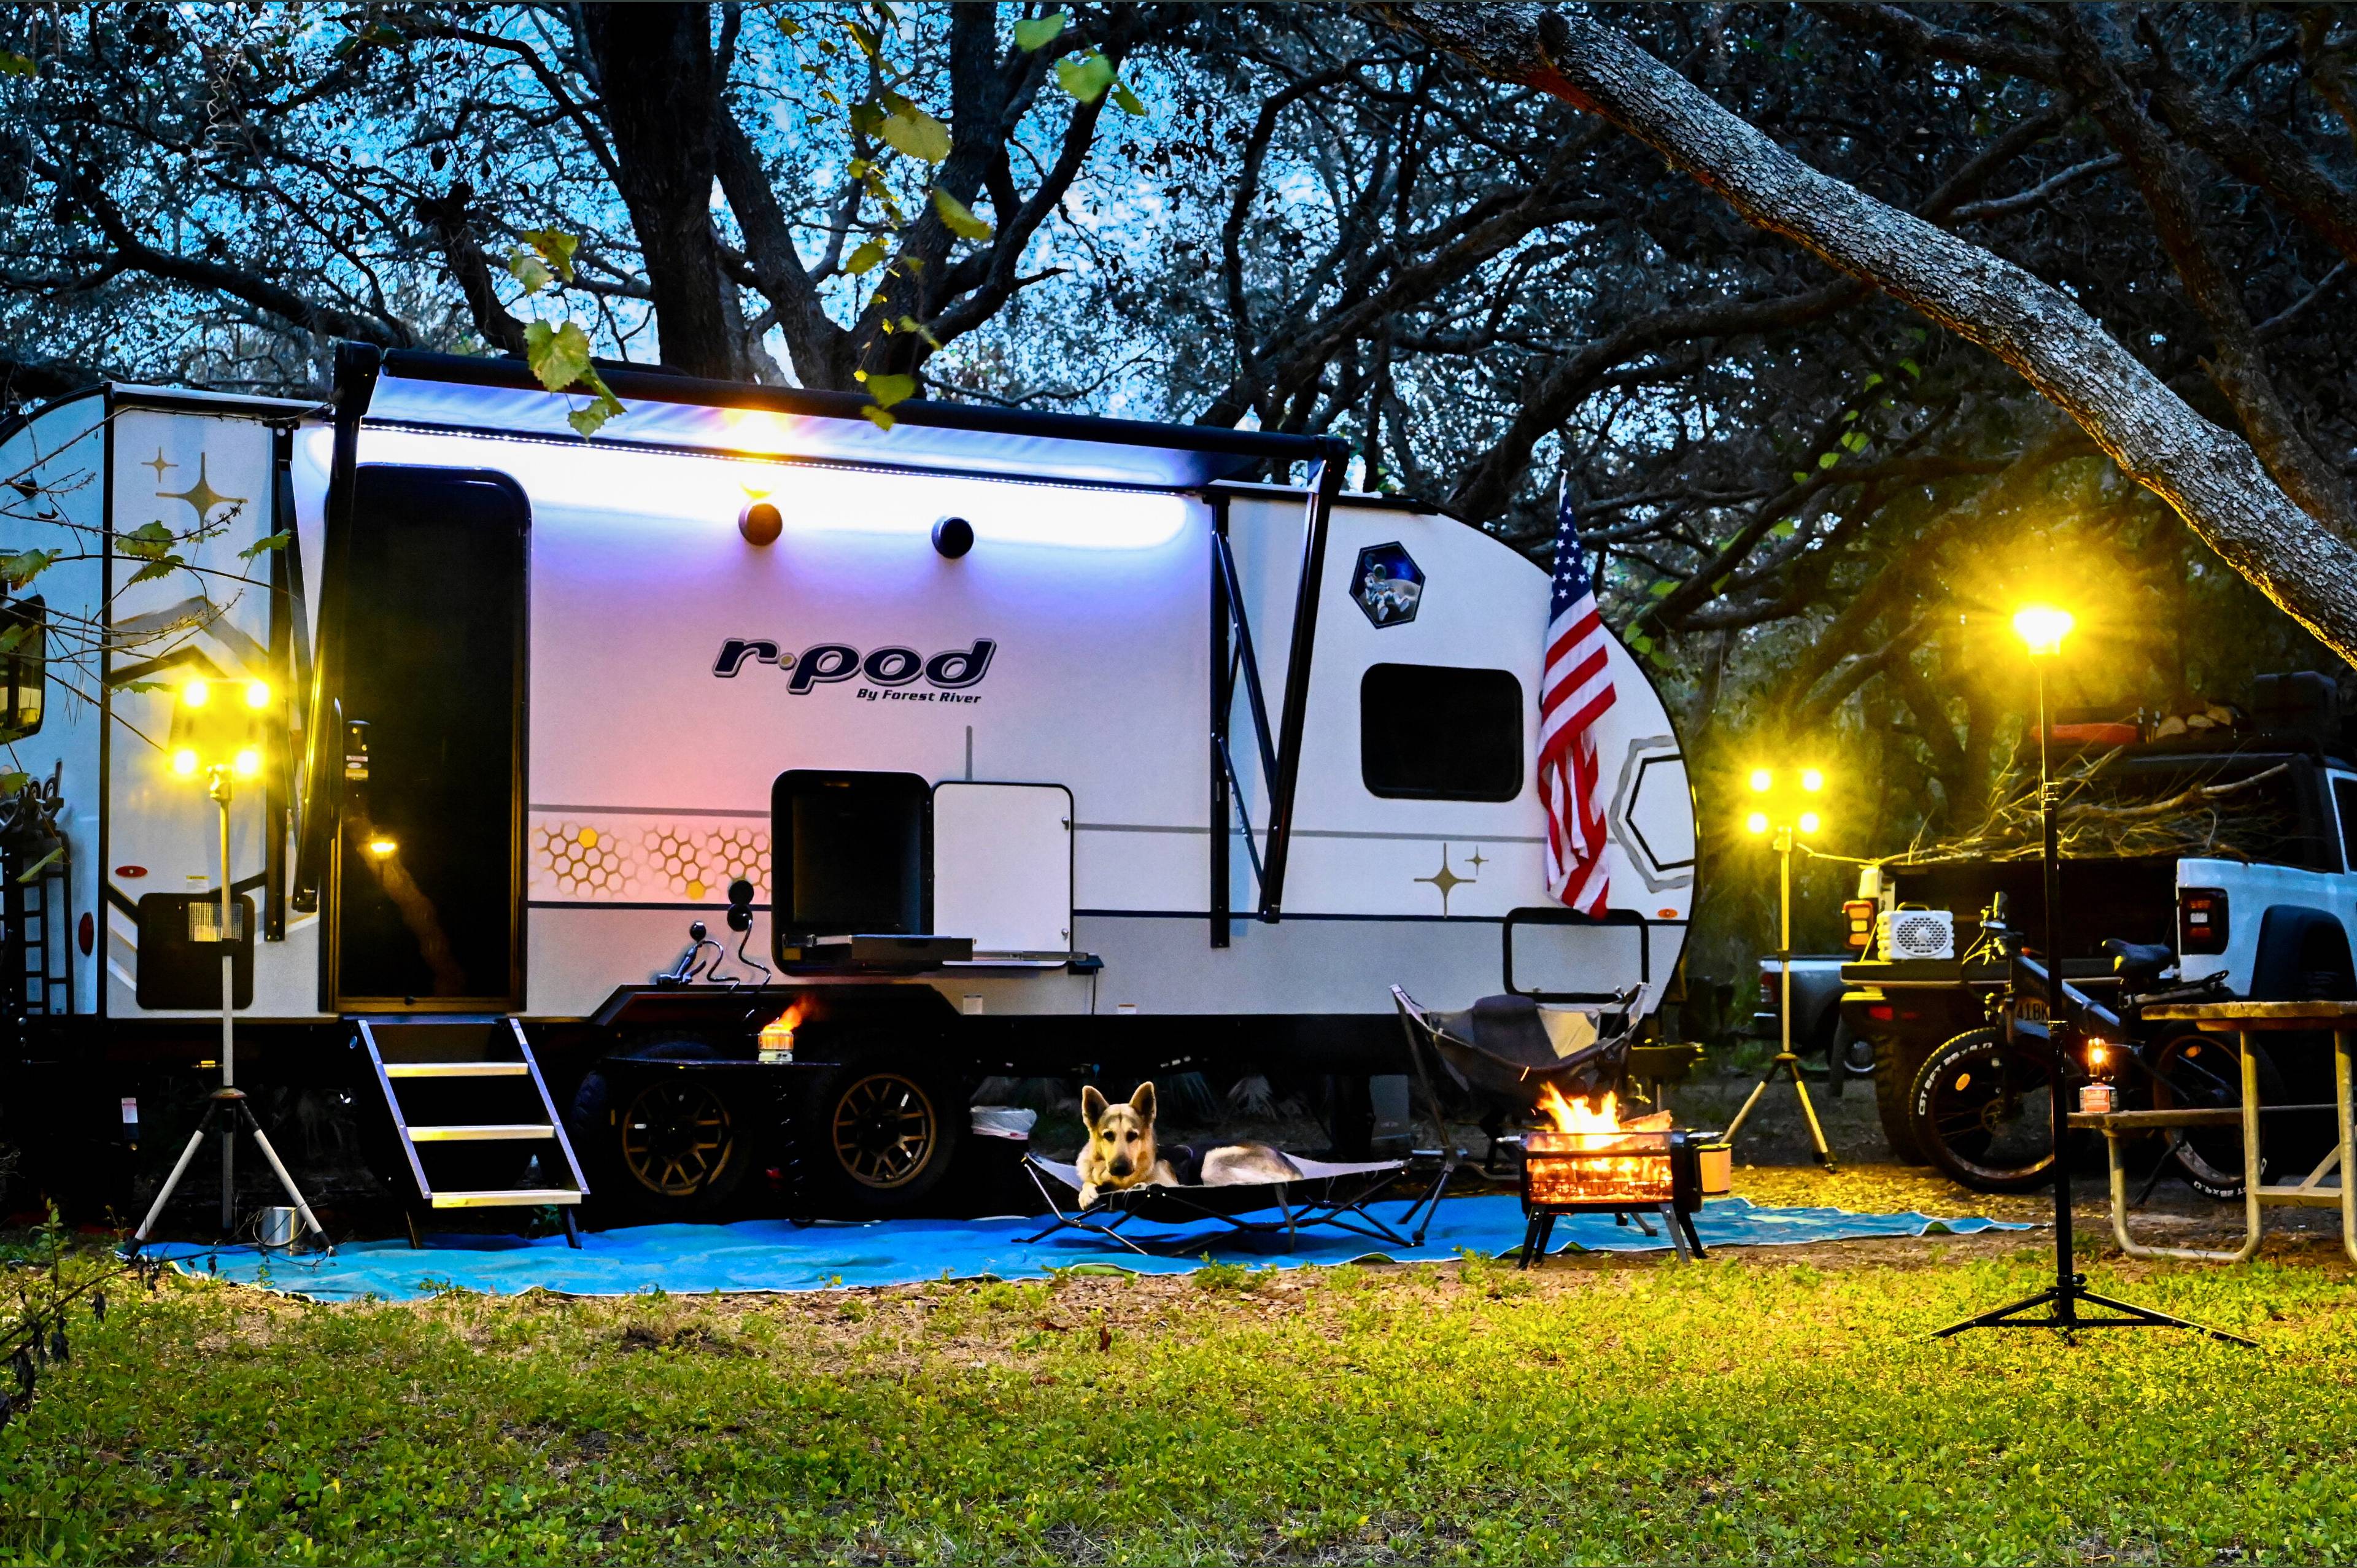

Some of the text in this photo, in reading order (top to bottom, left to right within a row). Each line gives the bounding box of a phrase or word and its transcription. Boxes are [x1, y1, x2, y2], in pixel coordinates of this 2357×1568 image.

[856, 689, 981, 703] By Forest River
